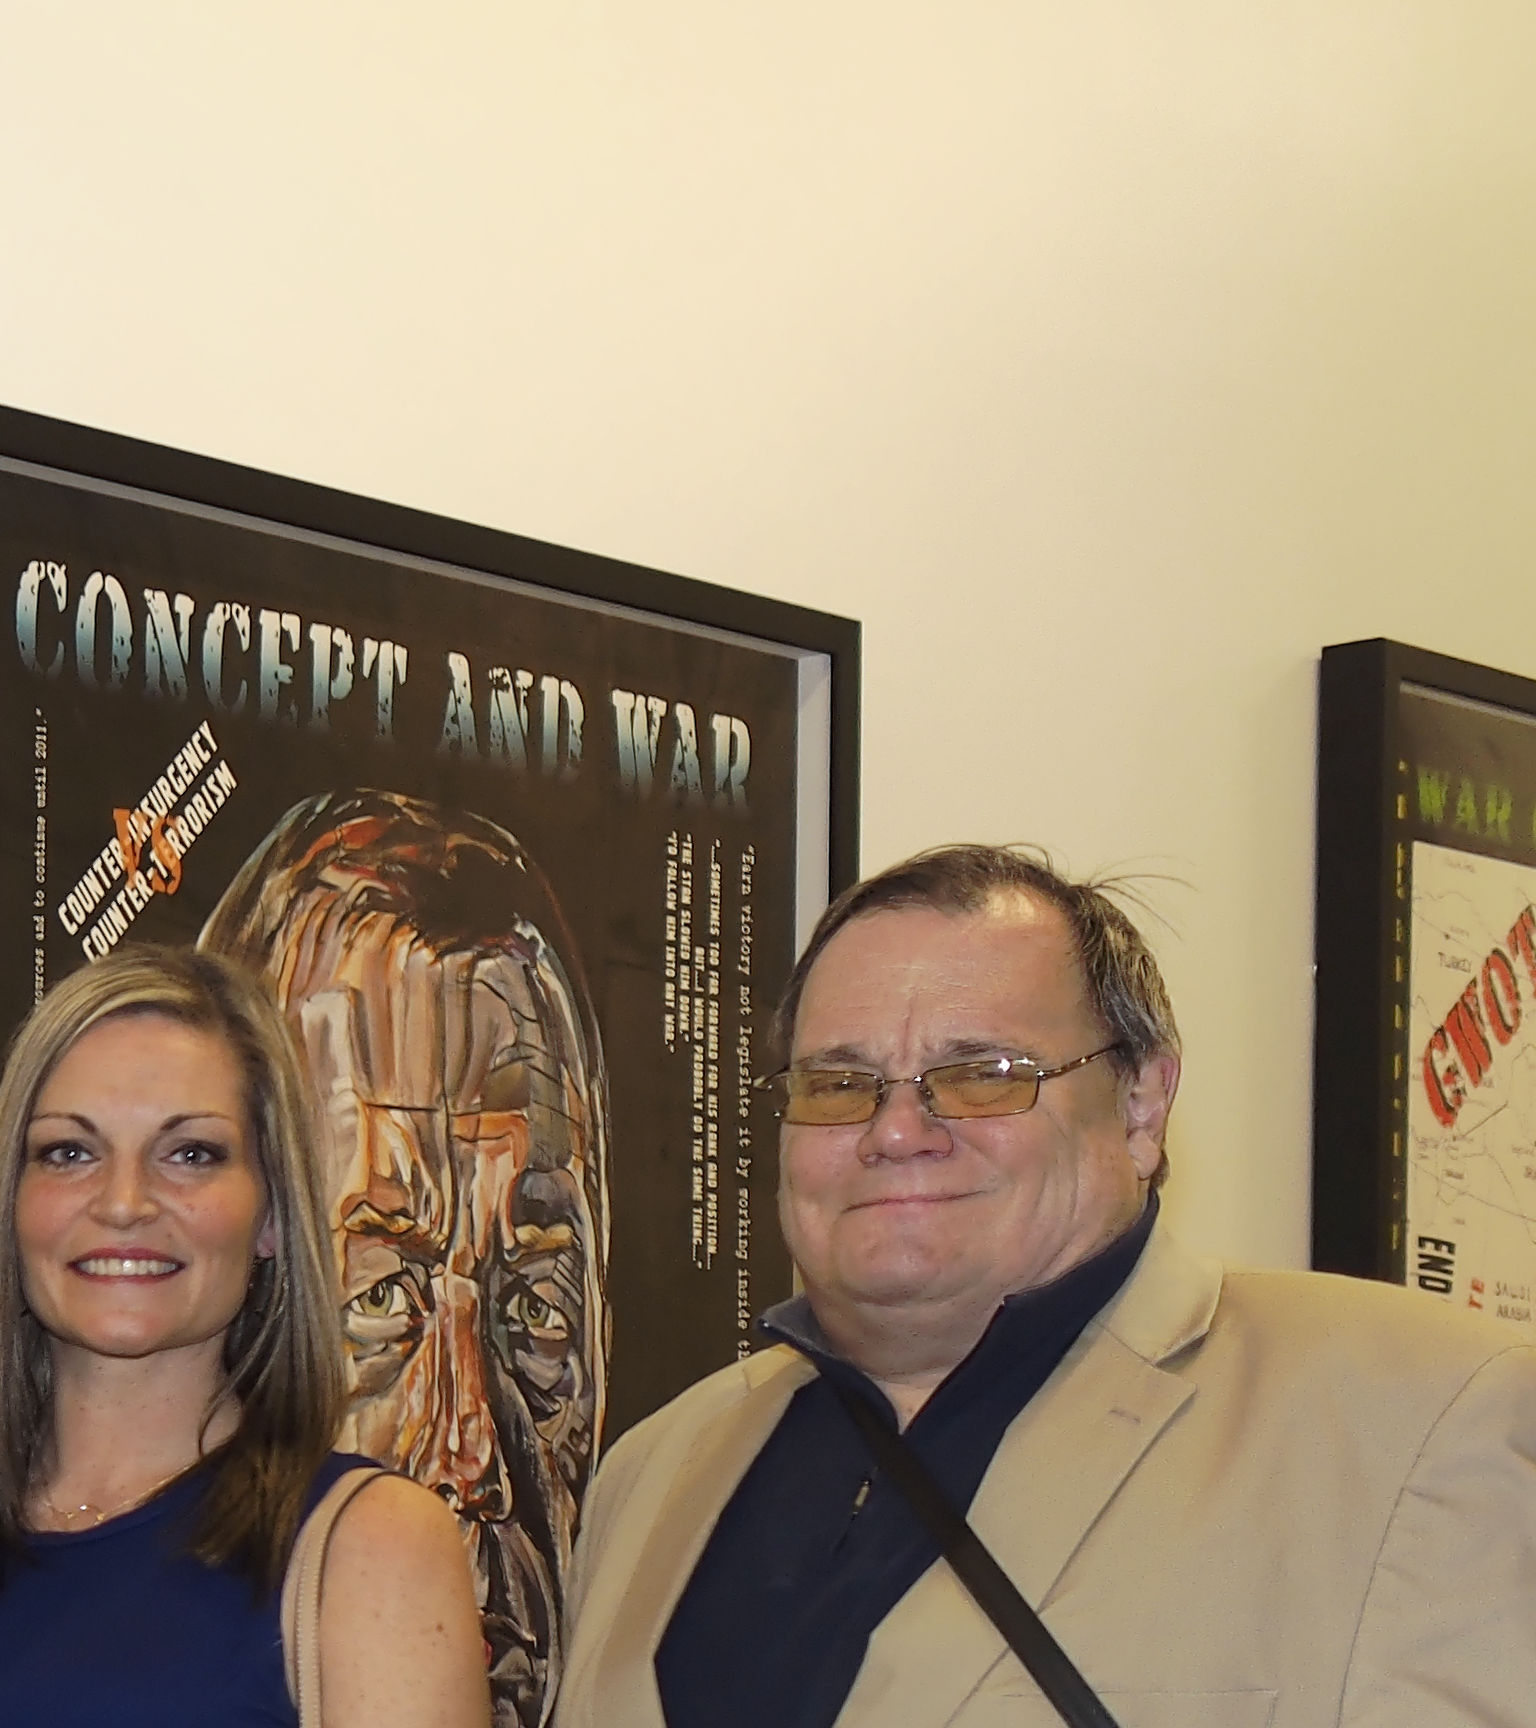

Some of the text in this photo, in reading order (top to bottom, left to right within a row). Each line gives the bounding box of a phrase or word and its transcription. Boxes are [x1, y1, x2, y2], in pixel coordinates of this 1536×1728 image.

[15, 559, 753, 803] CONCEPT AND WAR
[735, 1025, 753, 1118] legislate
[1417, 1236, 1456, 1295] END
